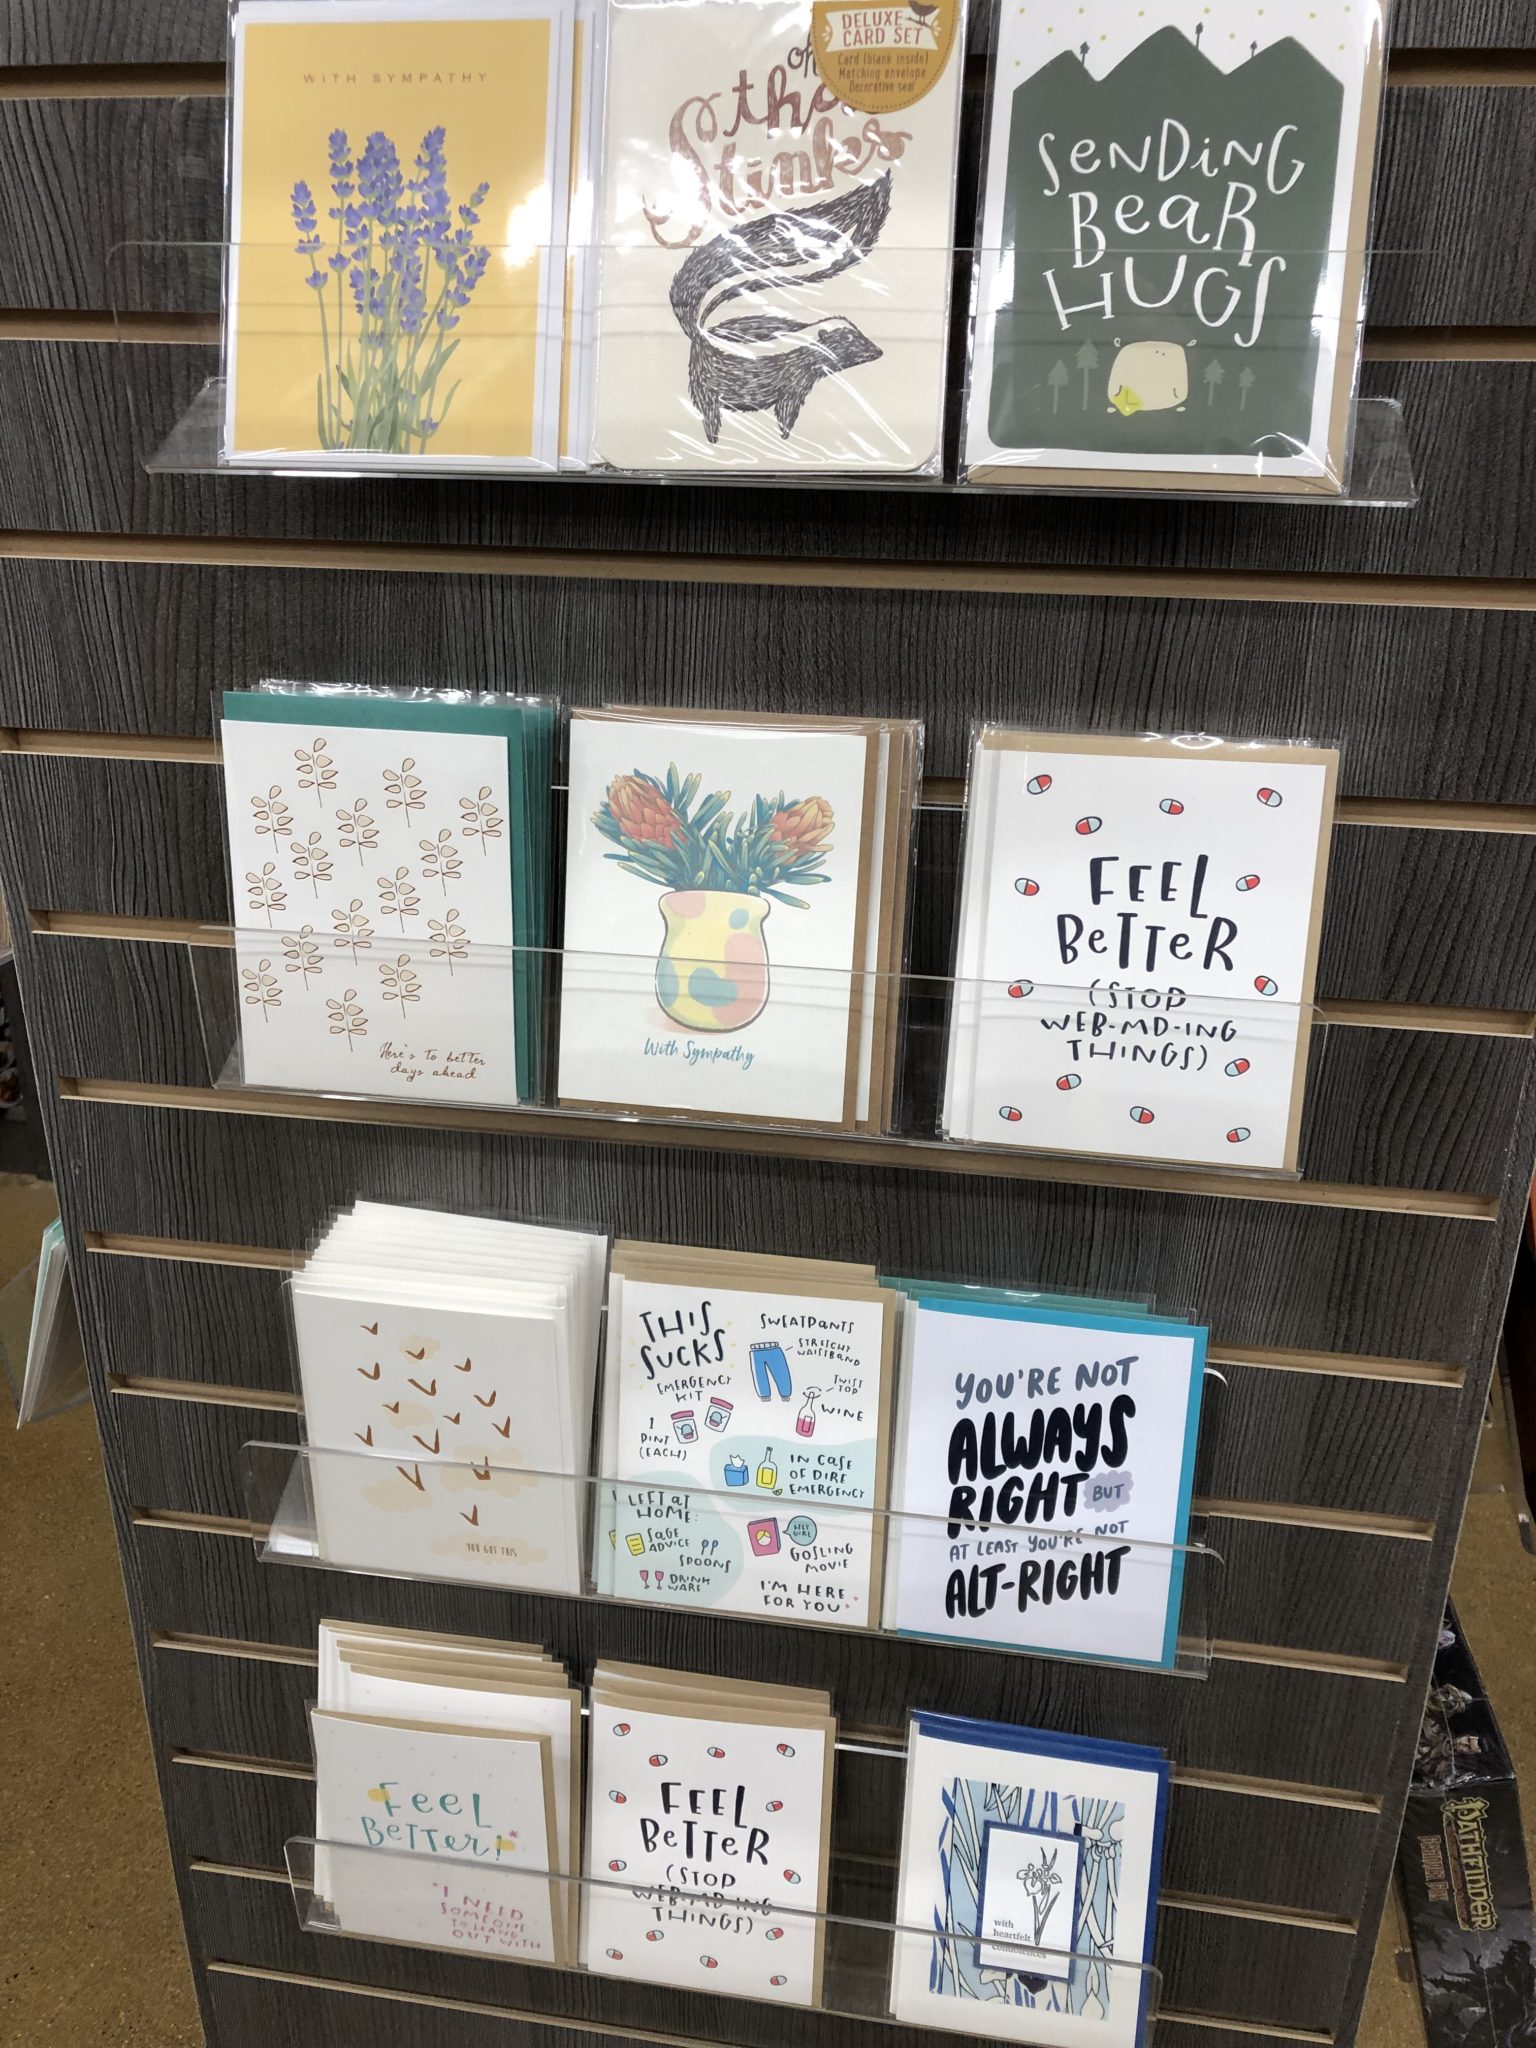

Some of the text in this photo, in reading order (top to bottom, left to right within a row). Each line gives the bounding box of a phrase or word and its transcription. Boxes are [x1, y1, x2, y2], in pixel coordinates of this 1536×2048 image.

[841, 10, 903, 30] DELUXE
[843, 27, 922, 47] CARD SET
[838, 54, 860, 65] Card
[896, 51, 929, 65] inside)
[302, 72, 489, 84] WITH SYMPATHY
[838, 67, 926, 81] Matching envelope
[897, 81, 916, 92] seal
[1043, 254, 1286, 348] HUGS
[1090, 854, 1209, 919] FEEL
[1089, 978, 1187, 1011] (STOP
[1040, 1011, 1237, 1042] WEB-MD-ING
[379, 1041, 486, 1066] Here's to better
[643, 1037, 754, 1071] With Sympathy
[1066, 1039, 1208, 1071] THINGS)
[390, 1062, 477, 1083] days ahead
[639, 1300, 712, 1343] THIS
[640, 1328, 726, 1380] SUCKS
[798, 1337, 851, 1353] STRETCHY
[656, 1374, 733, 1396] EMERGENCY
[833, 1374, 864, 1389] TWIST
[838, 1385, 859, 1395] TOP
[955, 1356, 1139, 1411] YOU'RE NOT
[674, 1390, 704, 1404] KIT
[821, 1403, 865, 1422] WINE
[640, 1432, 670, 1445] PINT
[948, 1394, 1136, 1485] ALWAYS
[638, 1446, 688, 1462] (EACH)
[789, 1453, 810, 1464] IN
[789, 1469, 848, 1485] OF DIRE
[628, 1490, 665, 1507] LEFT
[789, 1483, 866, 1499] EMERGENCY
[947, 1471, 1126, 1540] RIGHT BUT
[648, 1538, 691, 1553] ADVICE
[949, 1519, 1130, 1562] AT LEAST YOU'RE NOT
[790, 1543, 854, 1561] GOSLING
[679, 1554, 732, 1574] SPOONS
[805, 1559, 849, 1574] MOVIE
[667, 1583, 701, 1592] WARE
[669, 1573, 711, 1586] DRINK
[945, 1545, 1132, 1620] ALT-RIGHT
[760, 1580, 846, 1600] I'M HERE
[763, 1594, 841, 1613] FOR YOU
[661, 1782, 748, 1829] FEEL
[666, 1864, 737, 1889] (STOP
[451, 1918, 468, 1928] TO
[652, 1906, 753, 1935] THINGS)
[993, 1919, 1014, 1929] with
[452, 1929, 541, 1949] OUT WITH
[992, 1929, 1032, 1942] heartfelt
